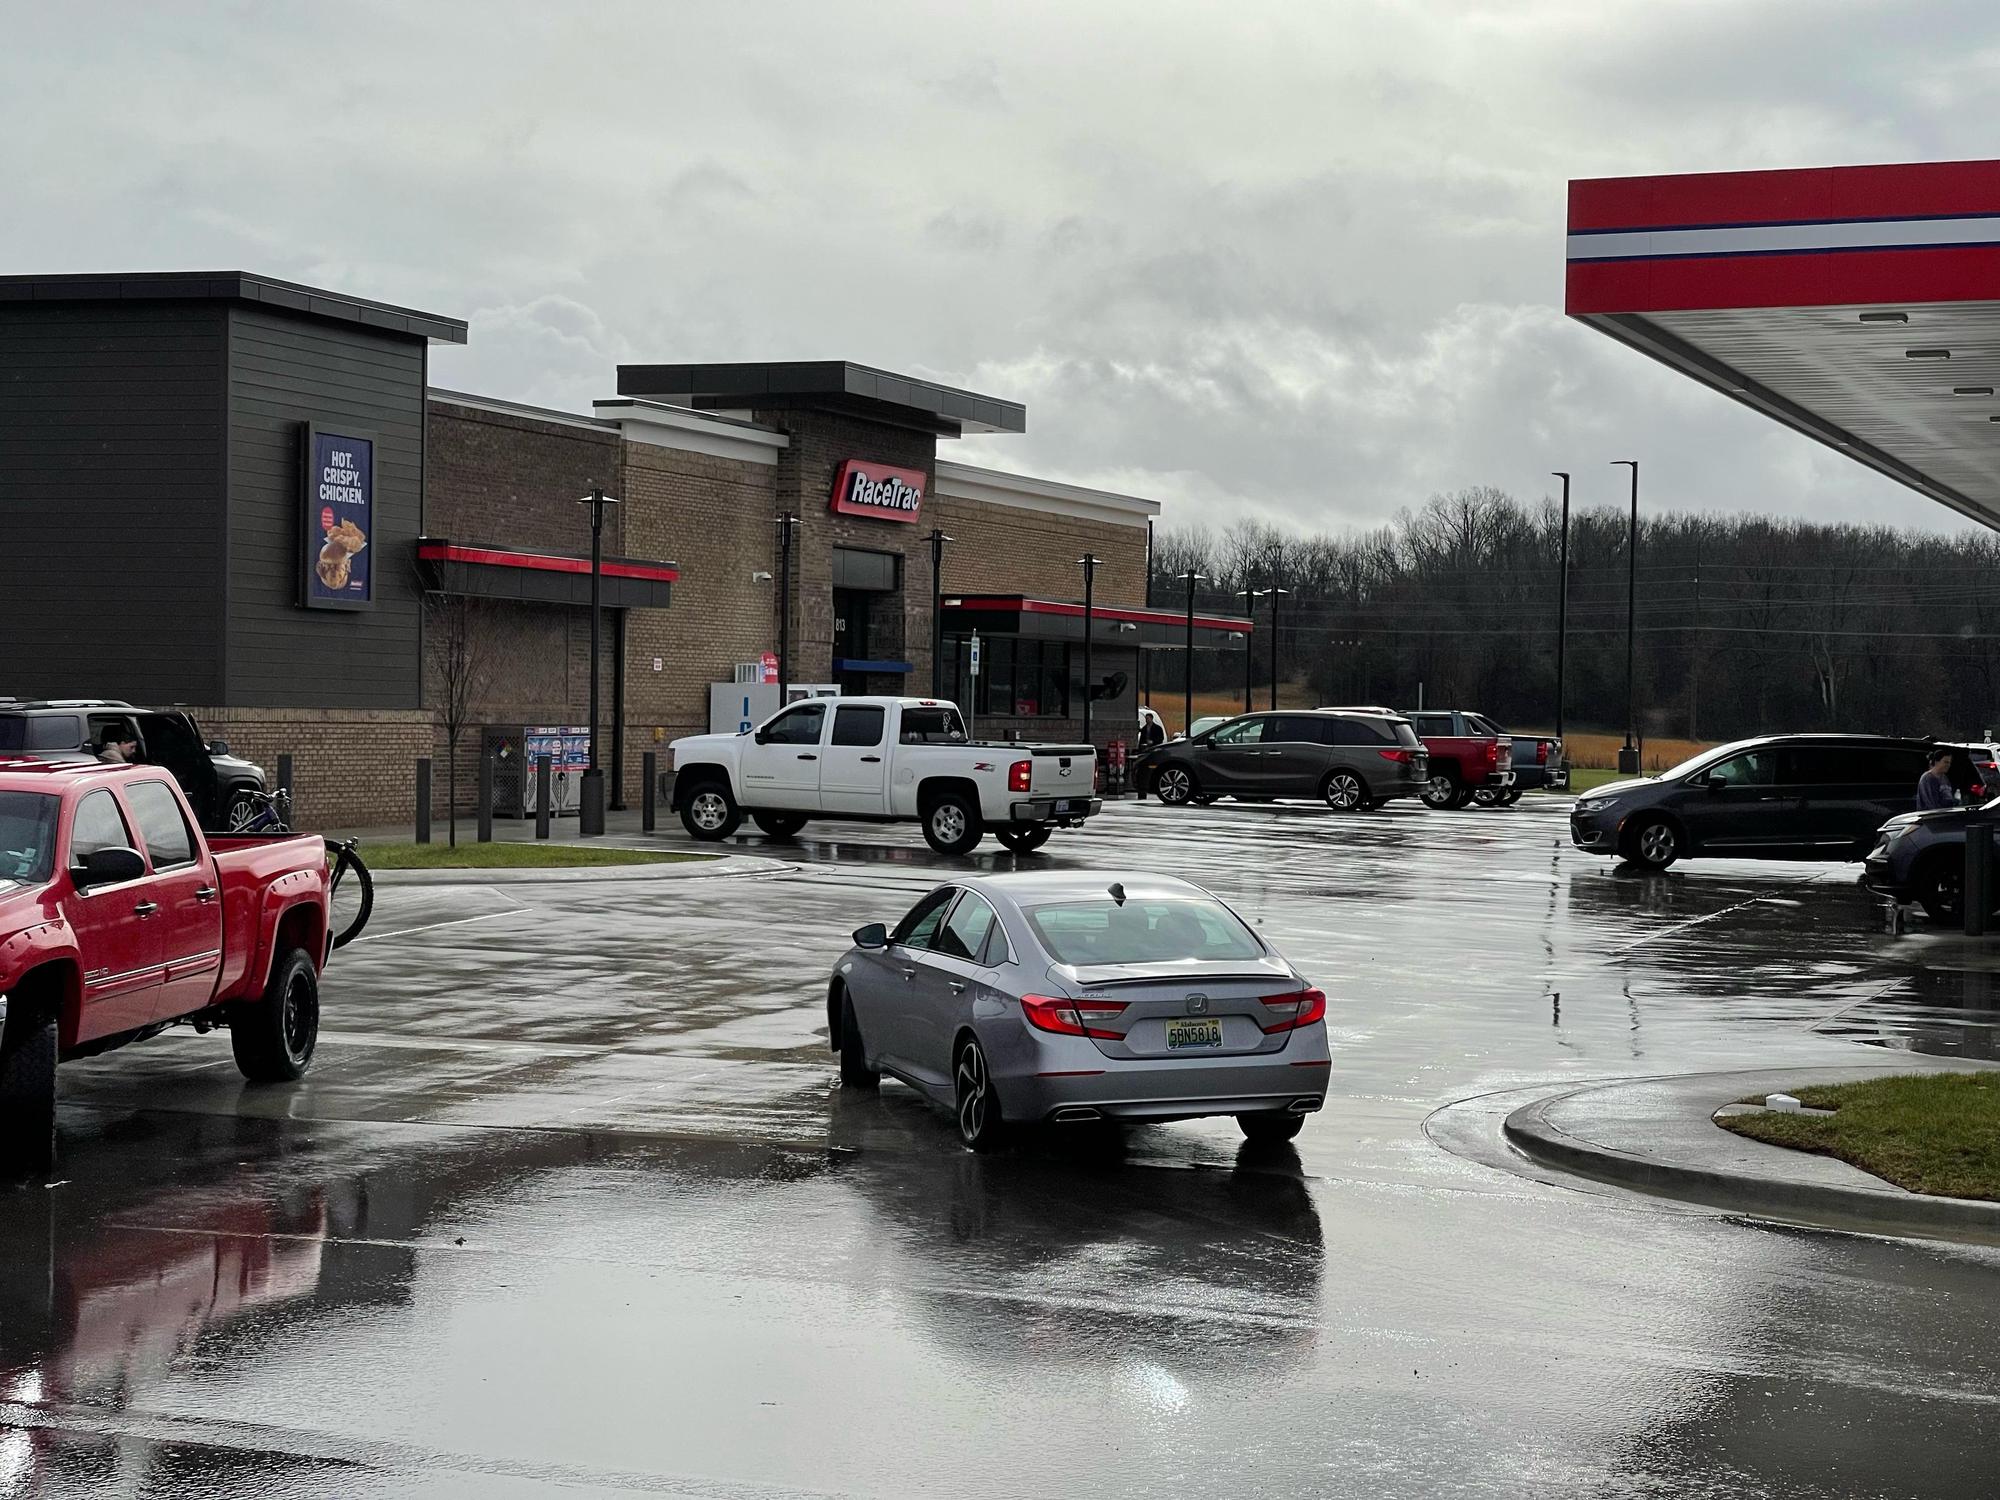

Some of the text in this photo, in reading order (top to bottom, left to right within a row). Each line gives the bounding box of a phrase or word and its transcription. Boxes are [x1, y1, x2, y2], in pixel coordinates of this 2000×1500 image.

[331, 450, 354, 469] HOT.
[323, 466, 361, 487] CRISPY.
[319, 483, 365, 505] CHICKEN.
[851, 471, 921, 511] RaceTrac
